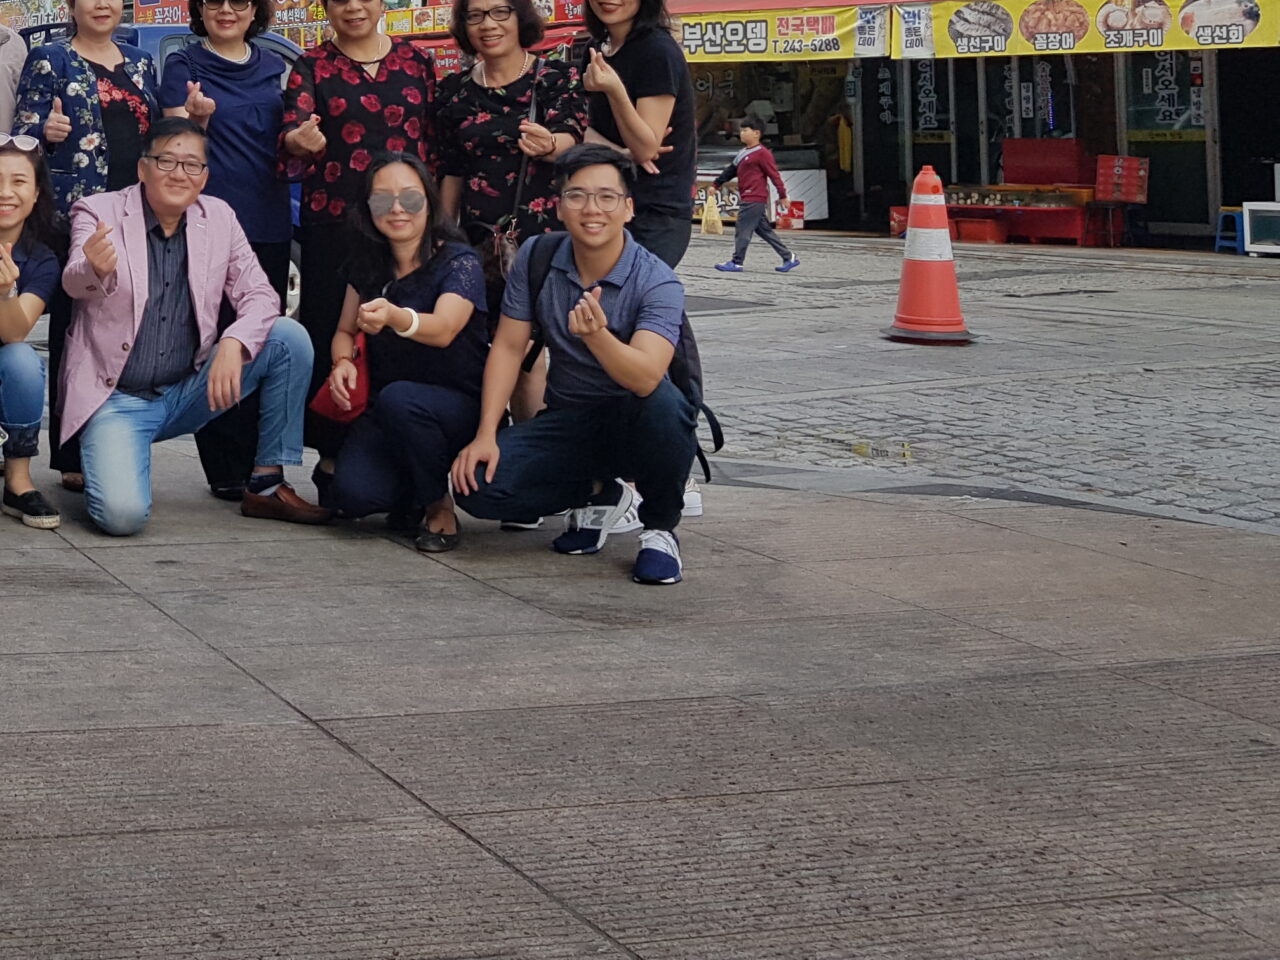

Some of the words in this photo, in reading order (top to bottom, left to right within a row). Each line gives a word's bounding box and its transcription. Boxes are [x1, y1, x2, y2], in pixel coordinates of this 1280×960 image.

[682, 19, 769, 56] 부산오뎅
[775, 13, 838, 38] 전국택배
[955, 34, 1006, 54] 생선구이
[1033, 31, 1076, 50] 꼼장어
[1105, 28, 1163, 48] 조개구이
[1196, 24, 1244, 45] 생선회
